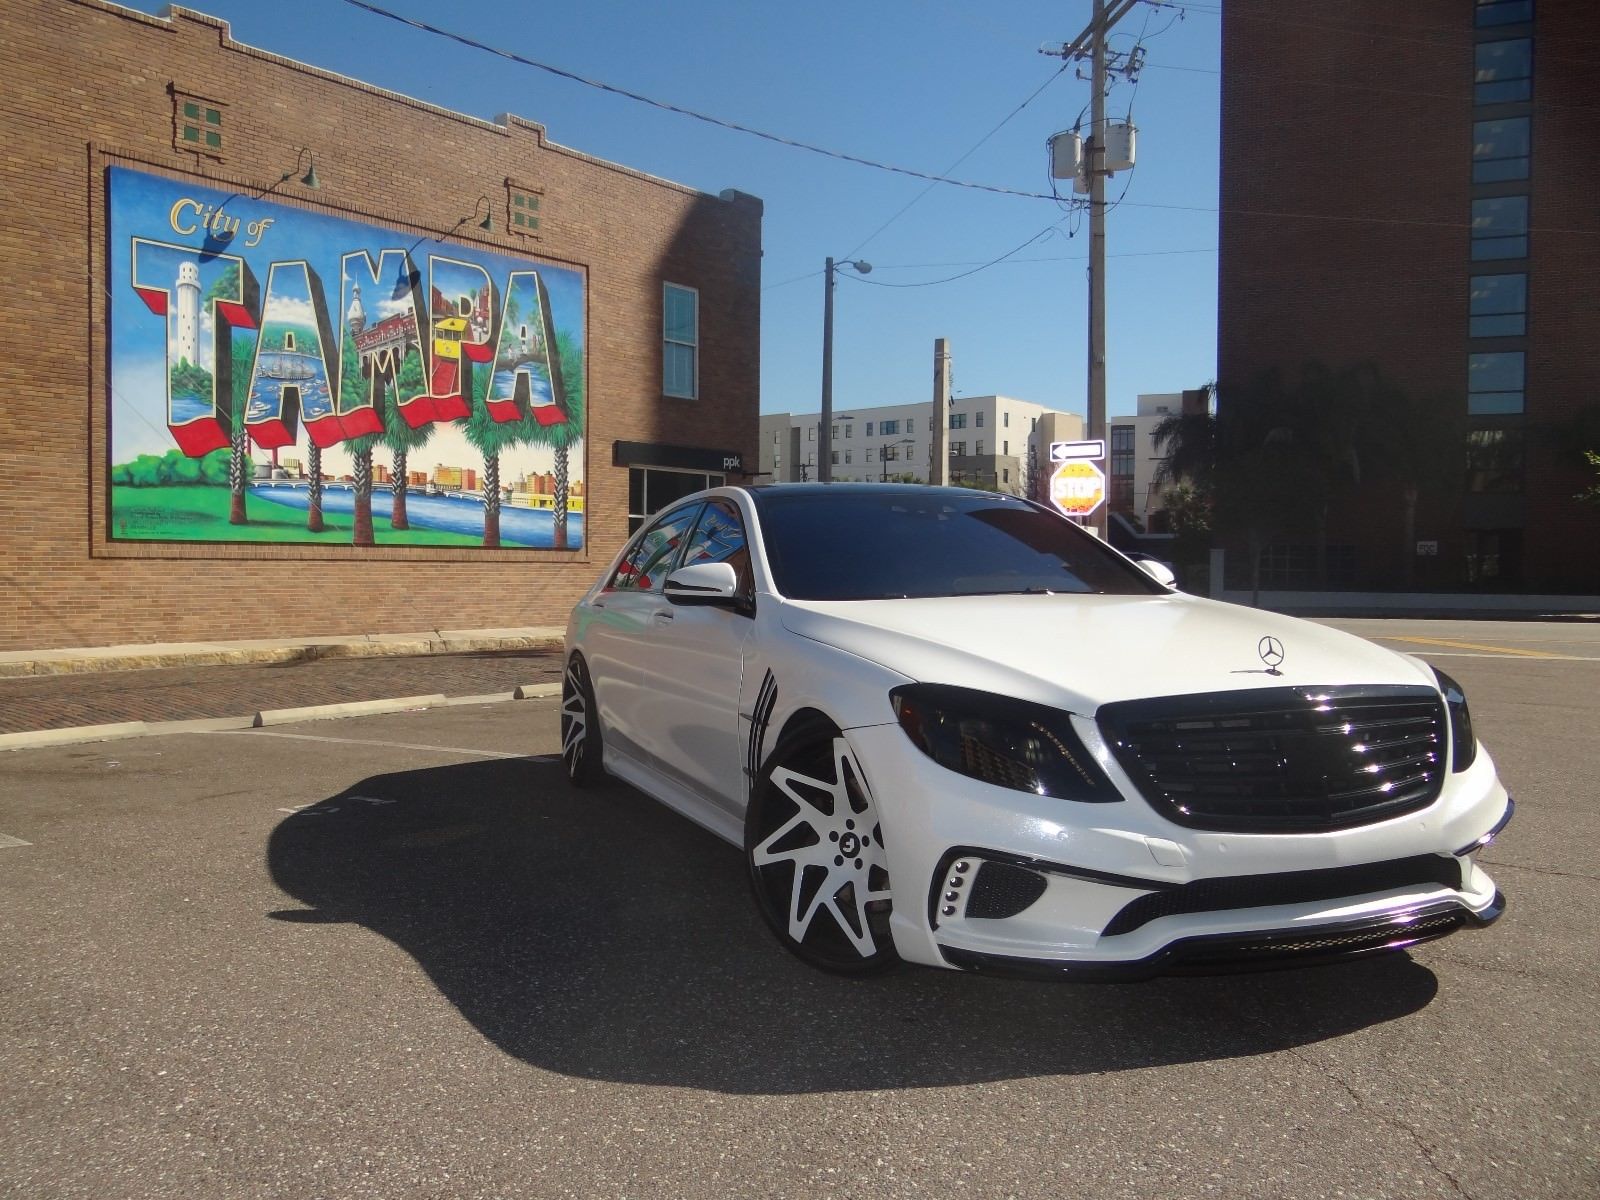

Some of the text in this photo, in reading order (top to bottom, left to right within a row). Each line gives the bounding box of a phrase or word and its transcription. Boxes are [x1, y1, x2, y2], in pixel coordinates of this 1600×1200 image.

[170, 198, 275, 247] City of
[131, 236, 568, 457] TAMPA
[723, 456, 741, 470] ppk
[1054, 477, 1101, 499] STOP
